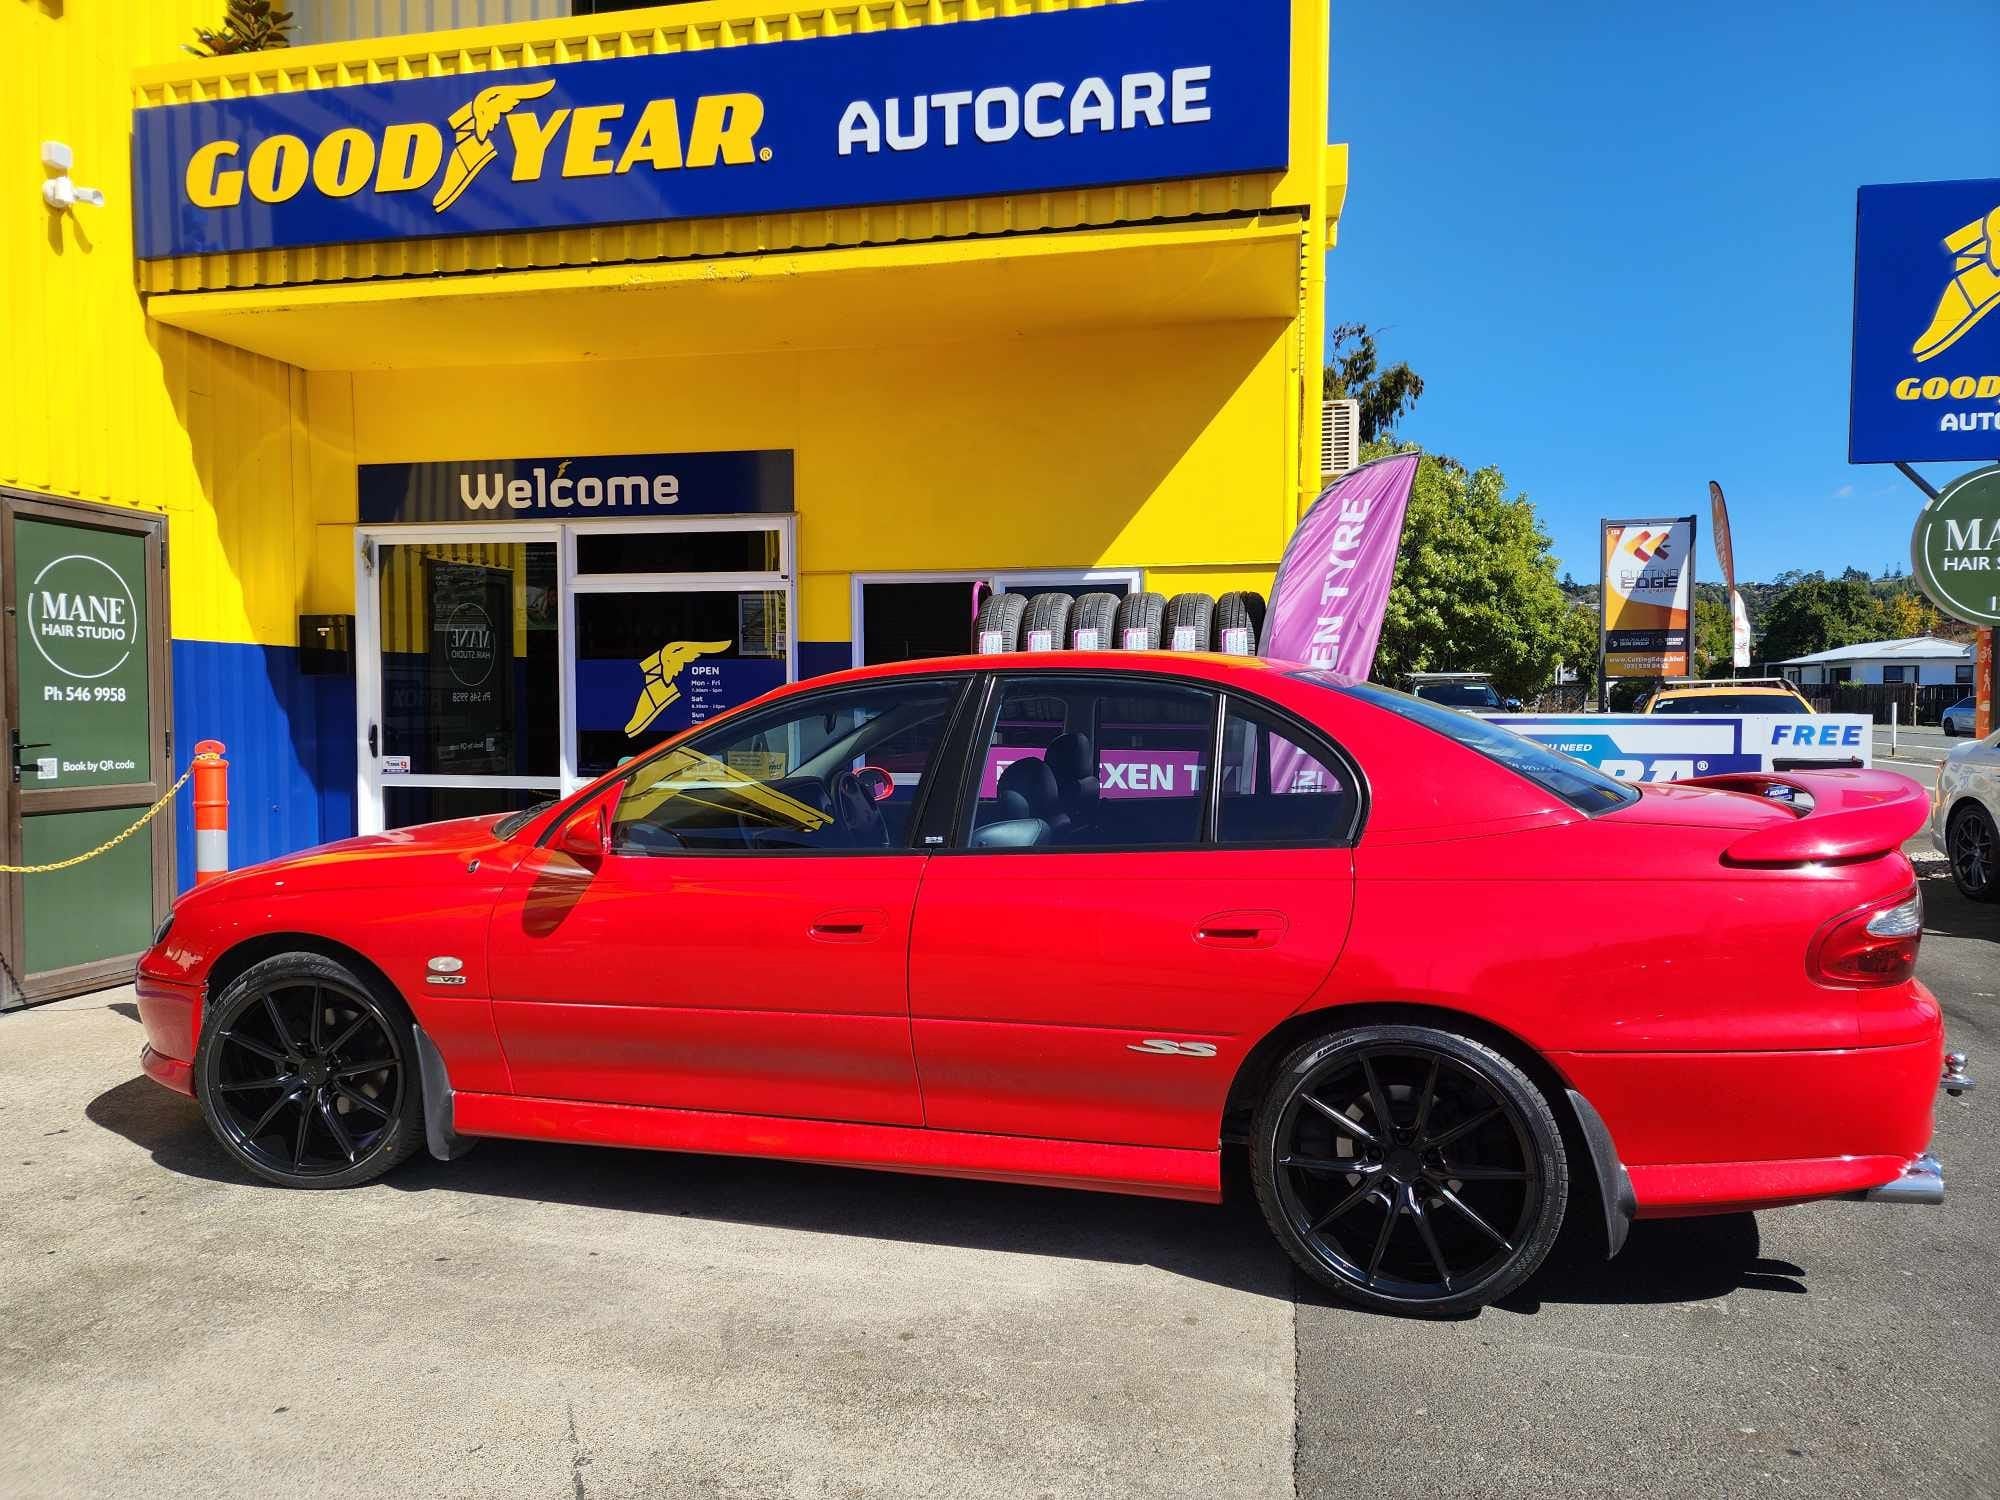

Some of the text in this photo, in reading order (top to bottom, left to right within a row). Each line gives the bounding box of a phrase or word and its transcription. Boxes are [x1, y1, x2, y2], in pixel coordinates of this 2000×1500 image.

[837, 65, 1213, 156] AUTOCARE
[460, 467, 679, 511] Welcome
[1320, 498, 1371, 606] TYRE
[1944, 556, 1991, 571] HAIR
[1621, 576, 1678, 589] EDGE
[41, 591, 125, 625] MANE
[41, 622, 126, 641] HAIR STUDIO
[691, 666, 720, 675] OPEN
[44, 686, 126, 702] Ph 546 9958
[1771, 724, 1864, 747] FREE
[1560, 743, 1593, 752] NEED
[62, 760, 135, 773] Book by QR code
[1098, 763, 1173, 791] XEN
